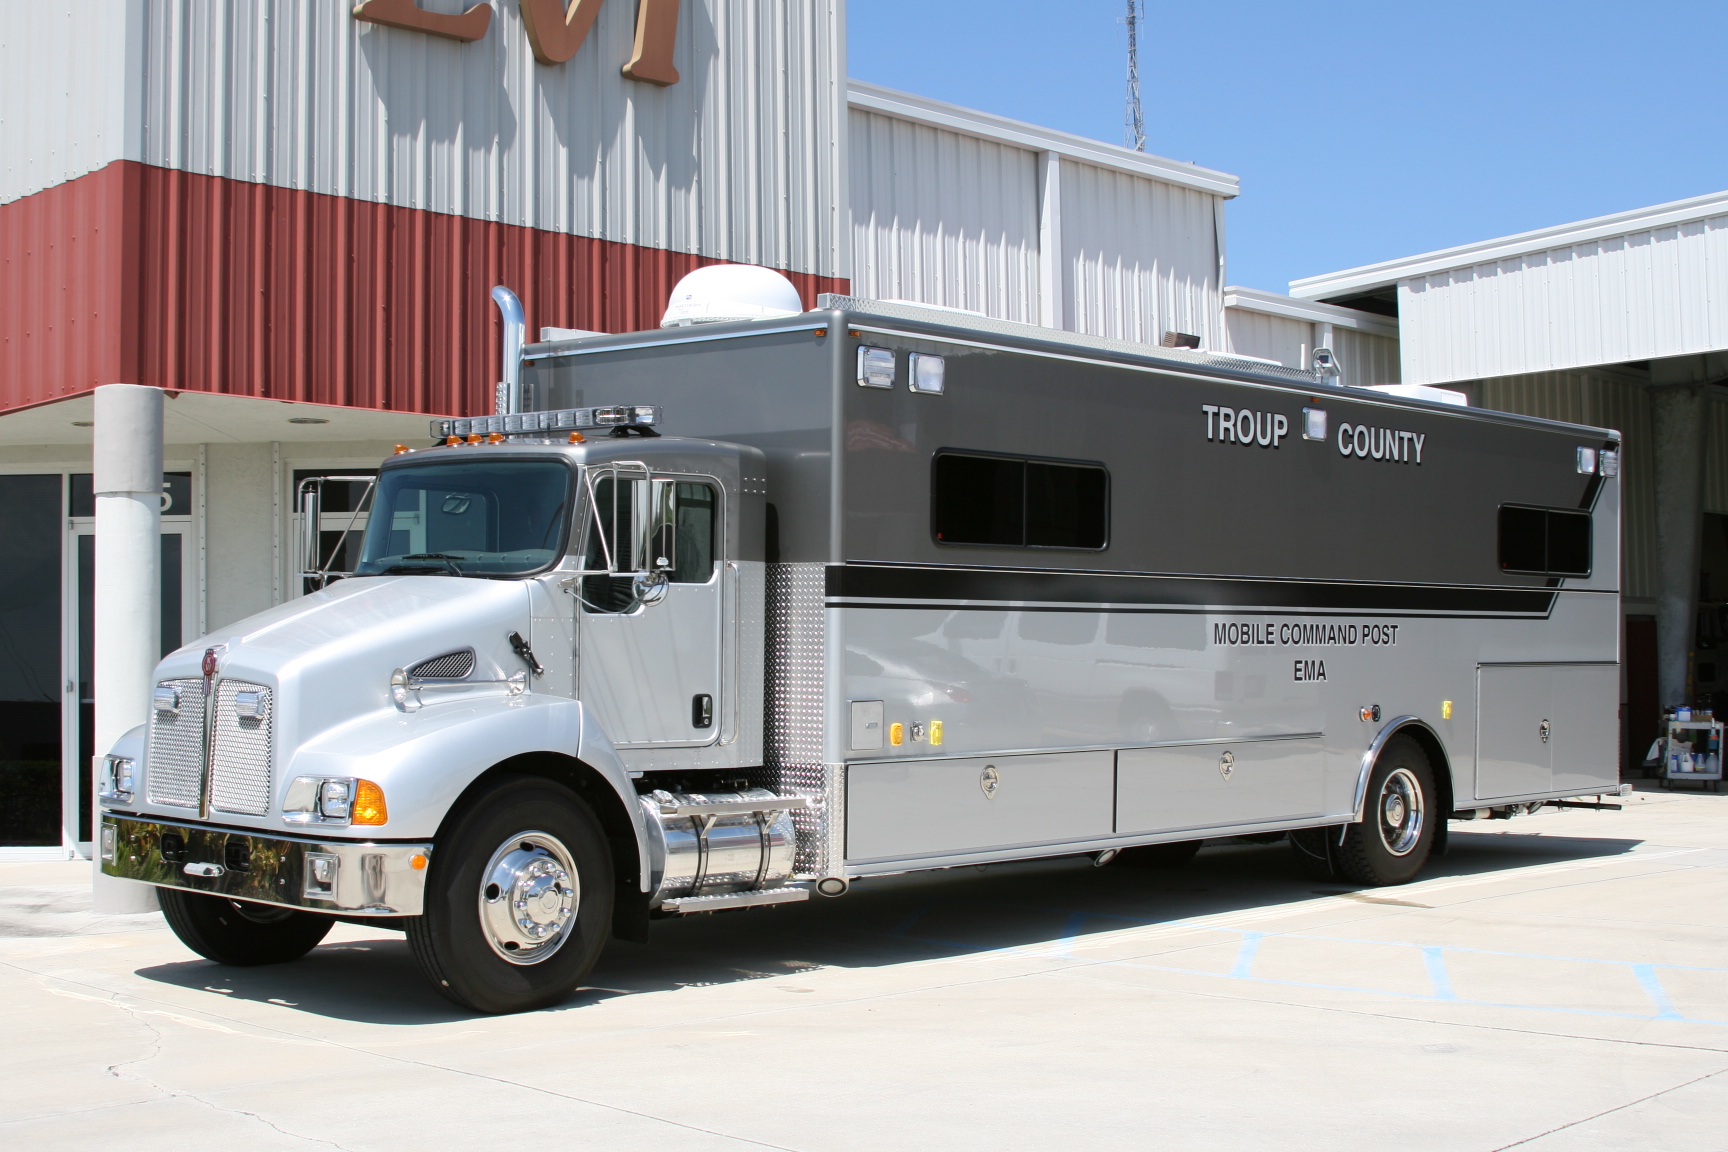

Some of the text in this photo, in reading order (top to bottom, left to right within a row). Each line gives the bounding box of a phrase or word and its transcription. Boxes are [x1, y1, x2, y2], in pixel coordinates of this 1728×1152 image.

[1202, 404, 1426, 464] TROUP COUNTY
[1213, 622, 1399, 646] MOBILE COMMAND POST
[1293, 659, 1328, 683] EMA
